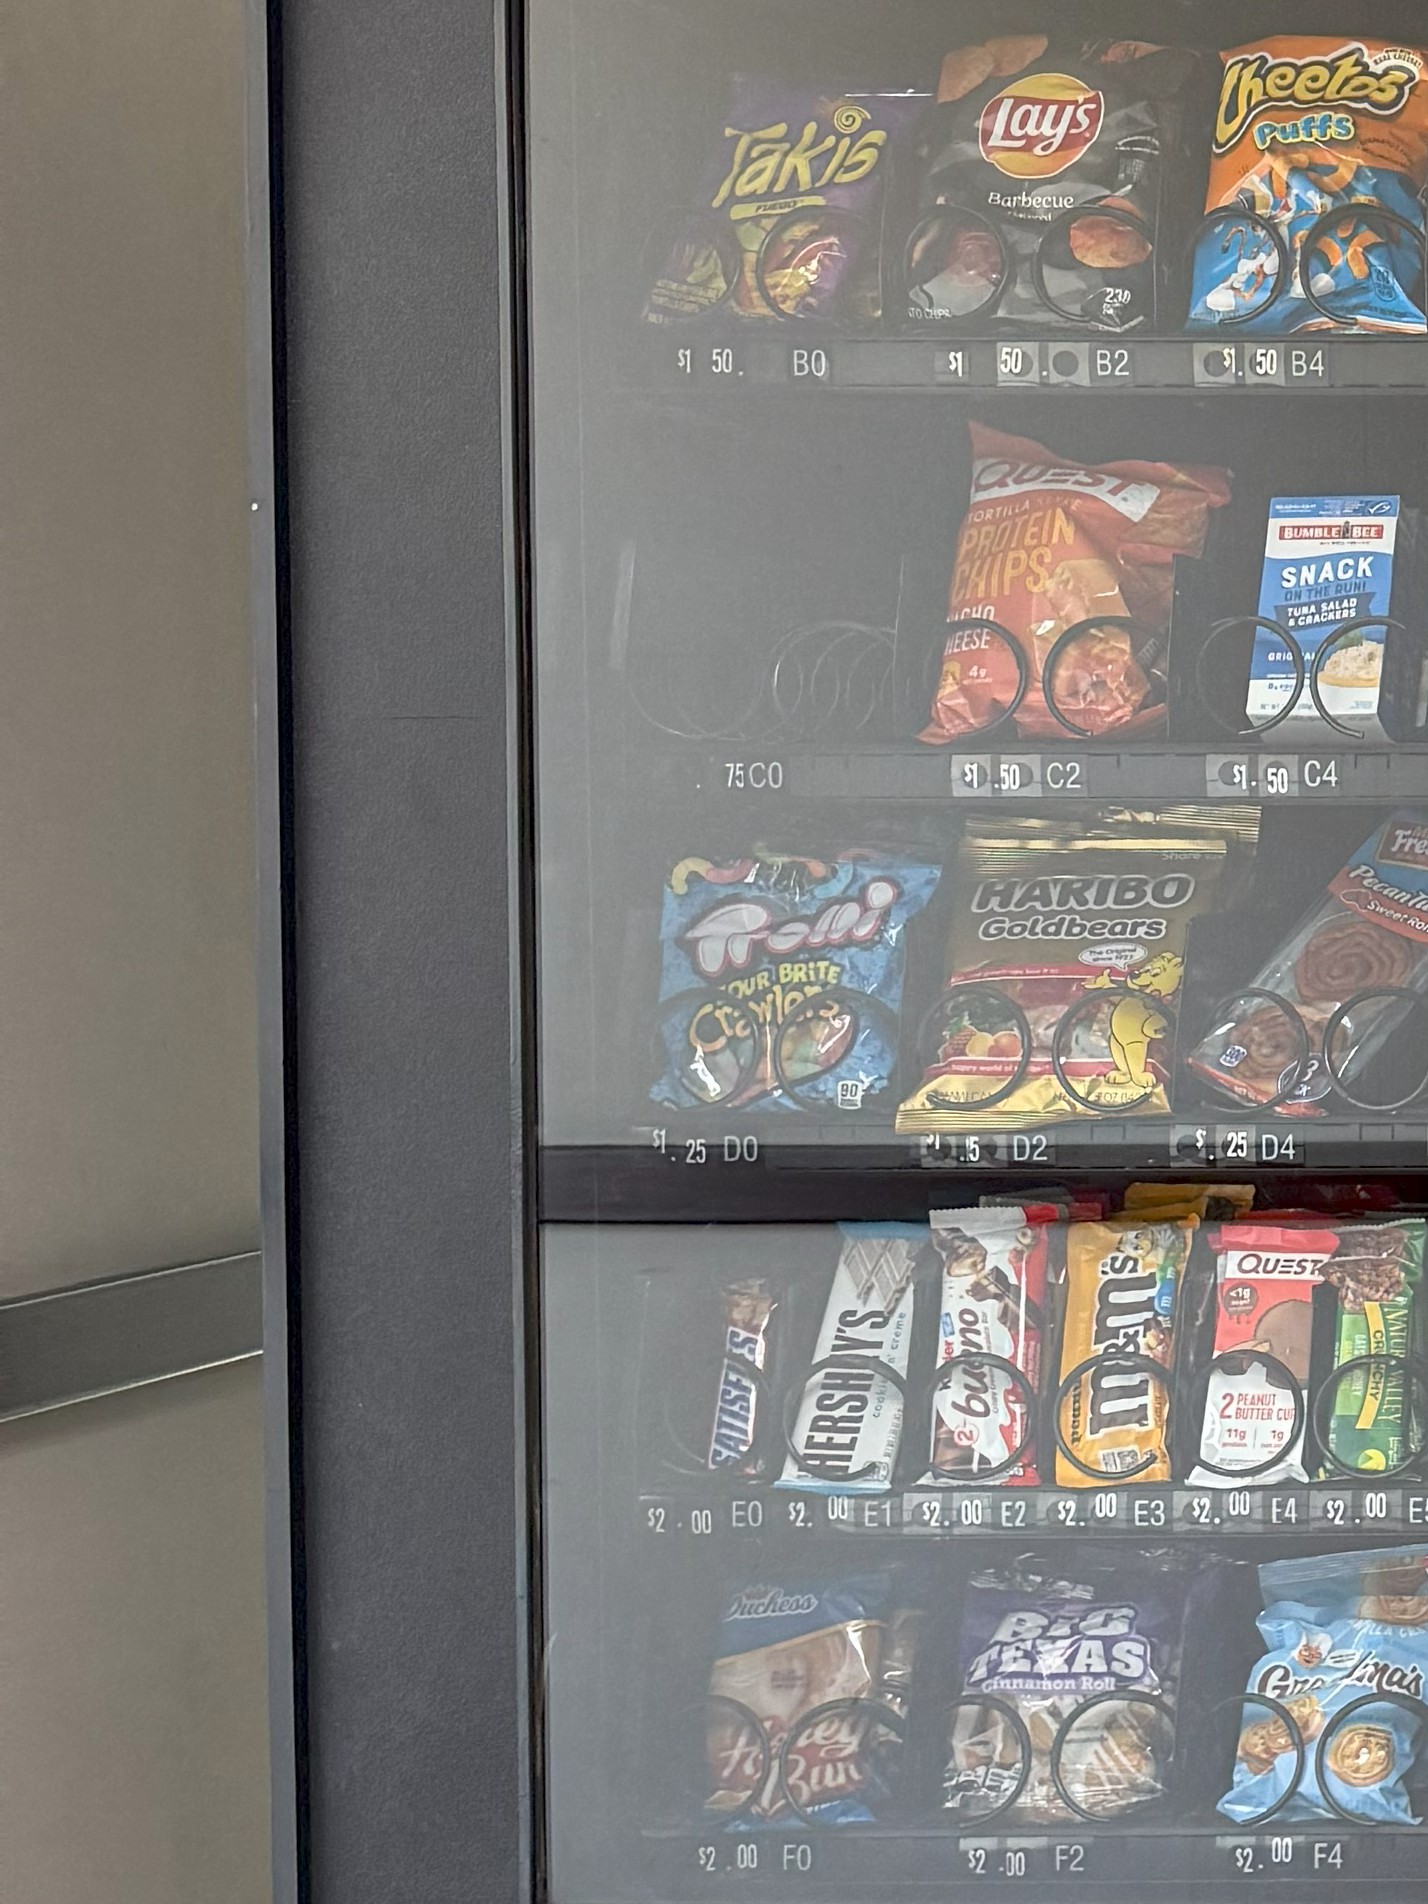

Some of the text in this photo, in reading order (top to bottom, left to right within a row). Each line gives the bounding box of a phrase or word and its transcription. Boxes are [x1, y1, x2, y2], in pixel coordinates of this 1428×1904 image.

[1214, 52, 1407, 151] Cheetos
[987, 93, 1098, 155] Lay's
[712, 104, 887, 208] Takis
[988, 190, 1074, 211] Barbecue
[793, 349, 826, 376] B0
[1097, 348, 1129, 376] B2
[1291, 352, 1325, 377] B4
[957, 508, 1076, 563] PROTEIN
[1283, 525, 1382, 539] BUMBLE BEE
[952, 548, 1055, 603] CHIPS
[1281, 556, 1374, 589] SNACK
[1287, 597, 1357, 619] TUNA SALAD
[749, 763, 783, 788] C0
[1047, 762, 1081, 788] C2
[1304, 761, 1338, 787] C4
[970, 874, 1195, 914] HARIBO
[1367, 900, 1407, 926] Sweet
[978, 917, 1166, 942] Goldbears
[724, 1136, 758, 1162] D0
[1013, 1135, 1048, 1161] D2
[1262, 1134, 1295, 1159] D4
[1236, 1393, 1277, 1408] PEANUT
[1235, 1406, 1276, 1421] BUTTER
[732, 1501, 763, 1526] E0
[865, 1501, 892, 1526] E1
[1001, 1500, 1026, 1525] E2
[1135, 1500, 1165, 1525] E3
[1271, 1500, 1298, 1524] E4
[970, 1641, 1147, 1684] TEXAS
[983, 1676, 1117, 1694] Cinnamon Roll
[783, 1846, 811, 1871] F0
[1056, 1846, 1085, 1871] F2
[1314, 1844, 1343, 1869] F4
